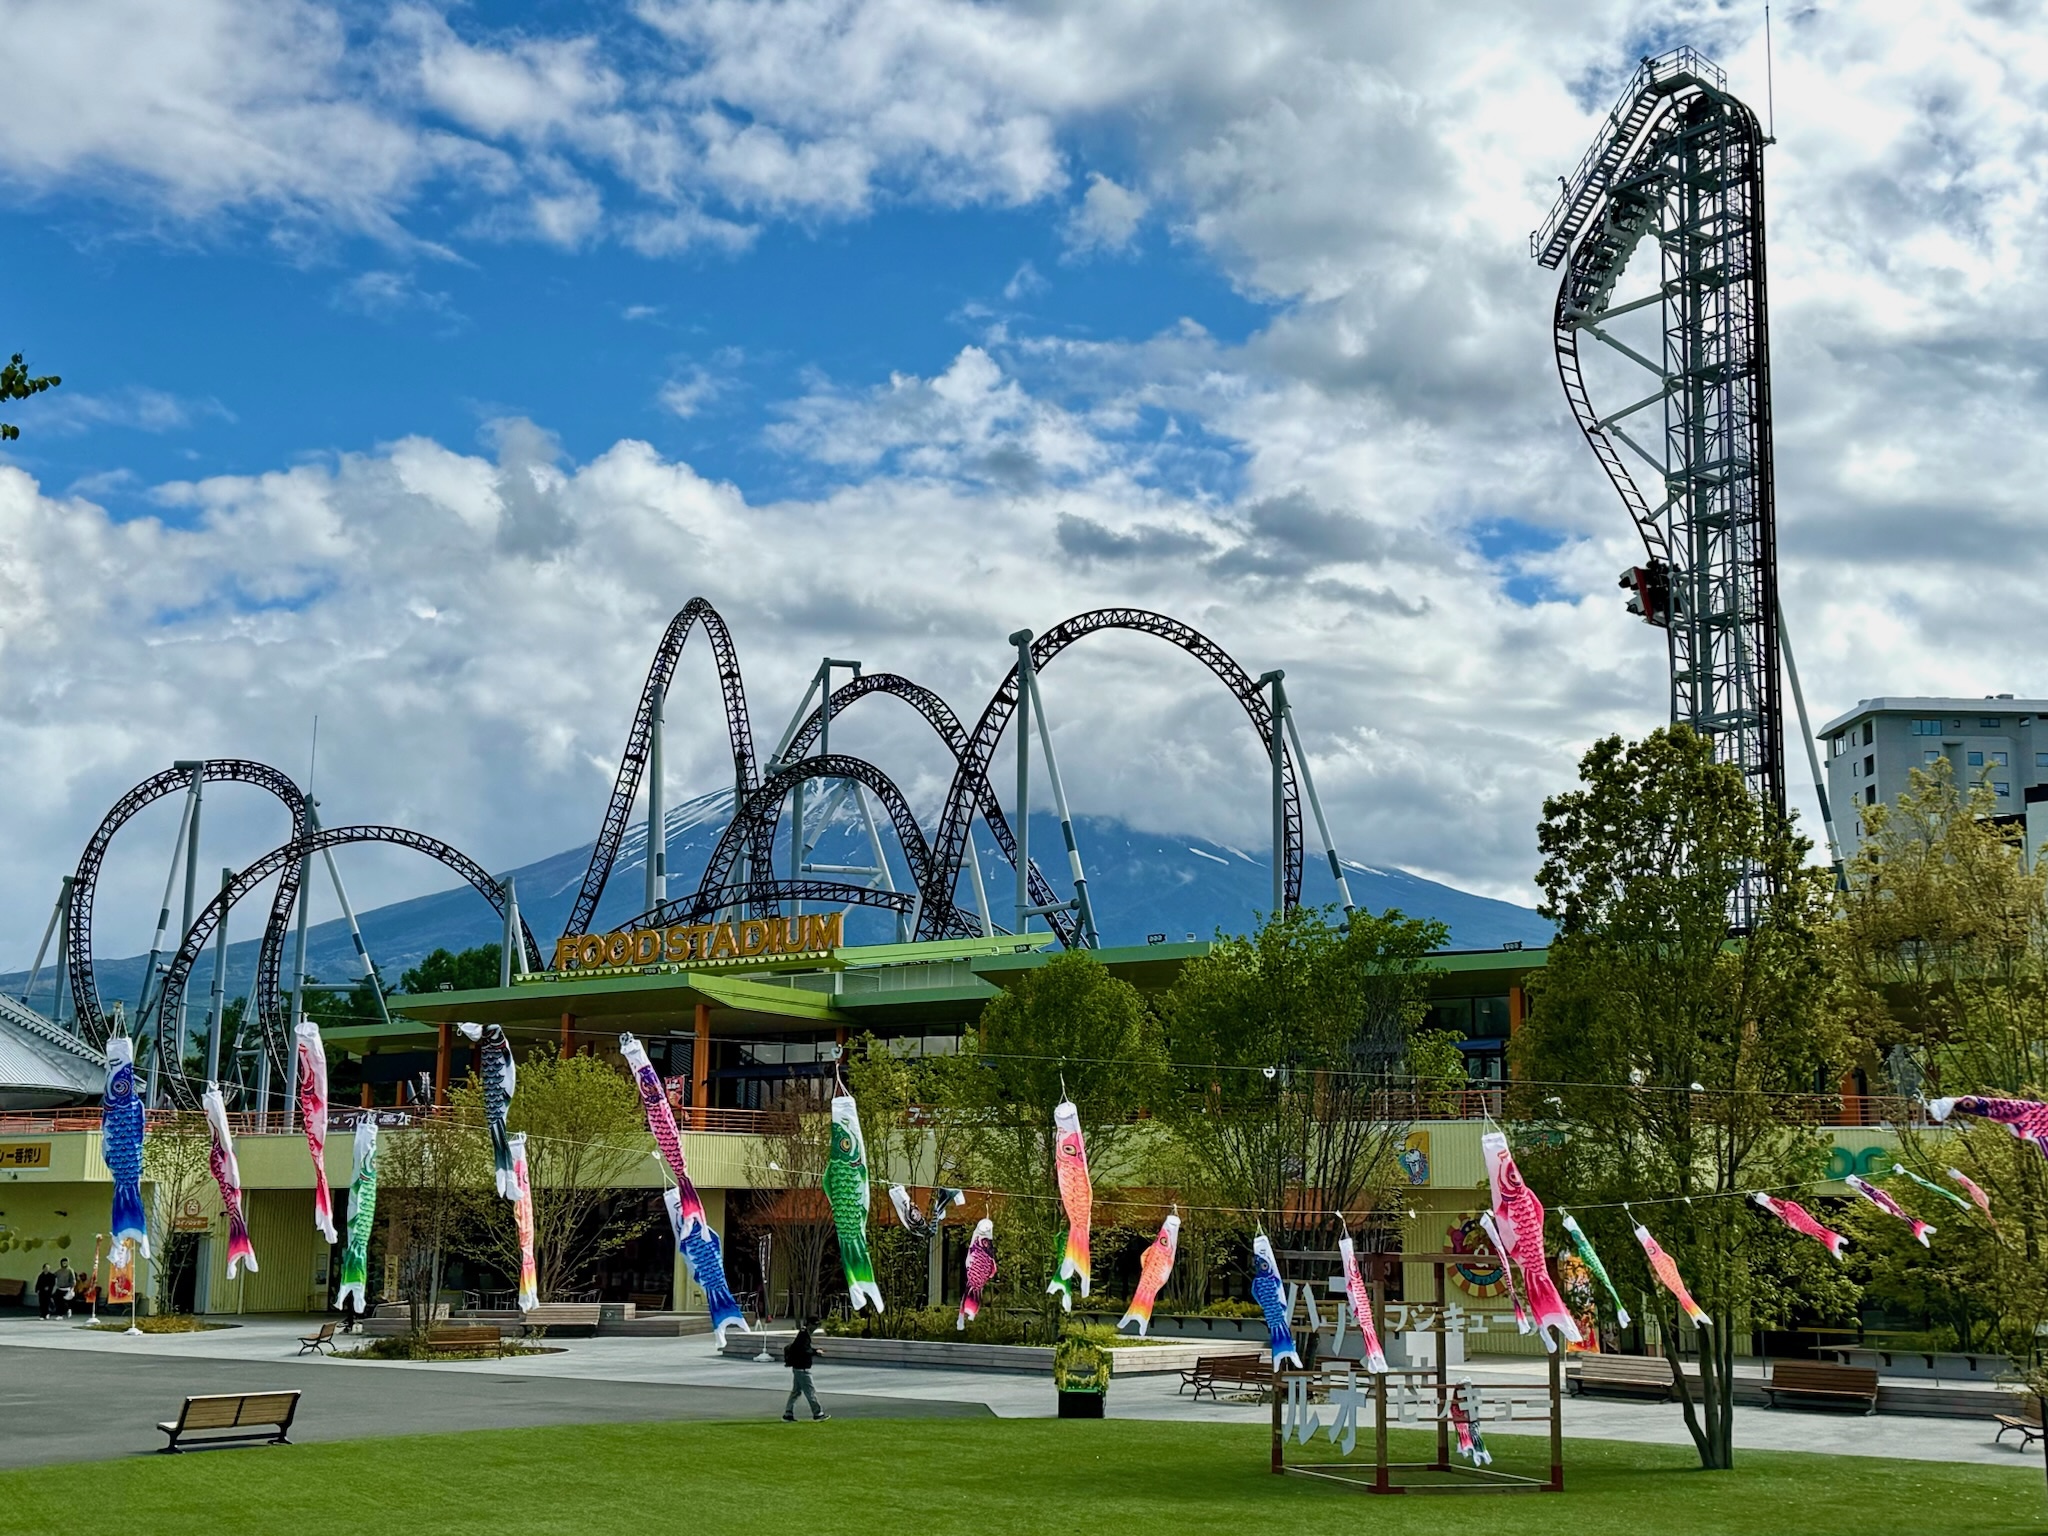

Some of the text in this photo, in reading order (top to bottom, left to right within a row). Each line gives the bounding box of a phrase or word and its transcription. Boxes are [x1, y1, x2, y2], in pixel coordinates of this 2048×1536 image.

[556, 912, 843, 970] FOOD STADIUM
[0, 1148, 41, 1163] 一番搾り
